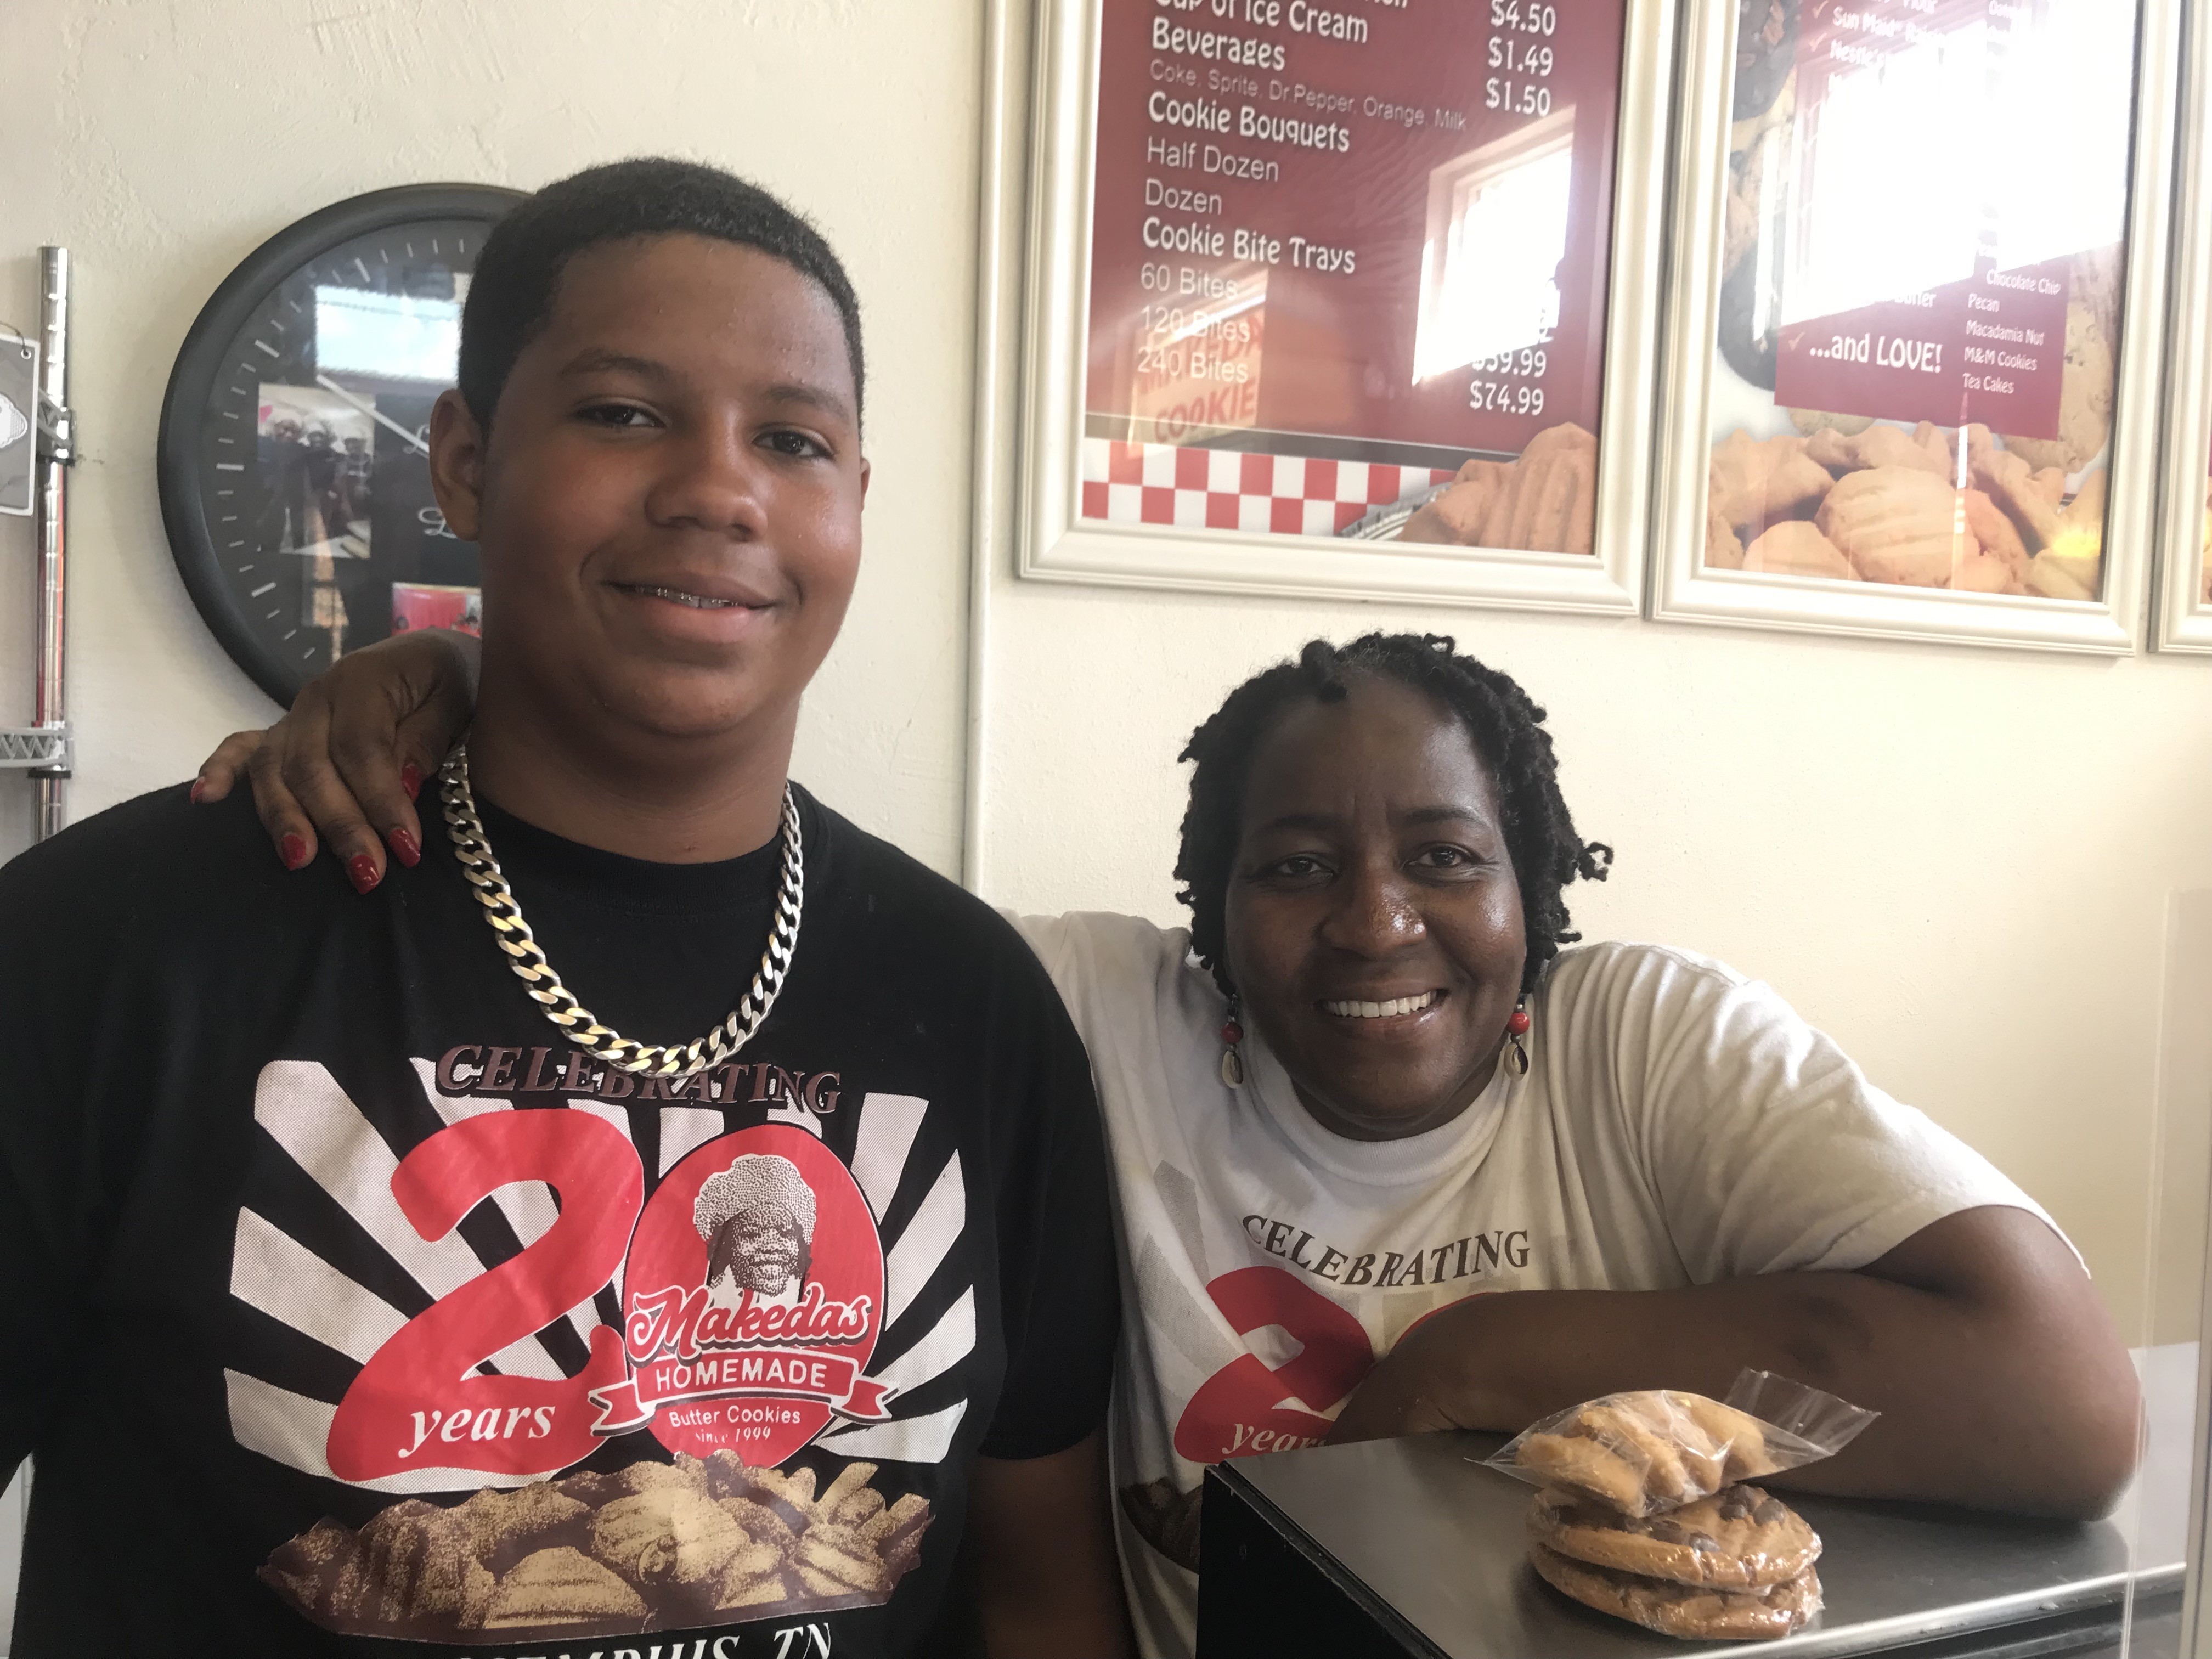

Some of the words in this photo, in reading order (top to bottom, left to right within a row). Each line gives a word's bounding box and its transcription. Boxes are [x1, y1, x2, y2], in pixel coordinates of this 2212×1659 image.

[1245, 0, 1280, 27] Ice
[1289, 0, 1368, 43] Cream
[1490, 0, 1556, 36] $4.50
[1152, 16, 1286, 71] Beverages
[1488, 35, 1554, 77] $1.49
[1485, 77, 1551, 117] $1.50
[1148, 91, 1232, 133] Cookie
[1239, 105, 1350, 153] Bouquets
[1435, 109, 1467, 131] Milk
[1147, 136, 1197, 169] Half
[1203, 145, 1279, 183] Dozen
[1145, 178, 1223, 215] Dozen
[1142, 215, 1225, 257] Cookie
[1233, 229, 1281, 264] Bite
[1289, 236, 1356, 274] Trays
[1141, 262, 1171, 292] 60
[1180, 267, 1238, 301] Bites
[1986, 269, 2037, 291] Chocolate
[2038, 278, 2062, 295] Chip
[1141, 304, 1184, 334] 120
[1968, 292, 2000, 312] Pecan
[1966, 319, 2024, 342] Macadamia
[2025, 329, 2045, 346] Nut
[1137, 346, 1181, 377] 240
[1190, 352, 1250, 384] Bites
[1810, 332, 1870, 363] ...and
[1876, 336, 1943, 374] LOVE!
[1964, 346, 1996, 365] M&M
[1997, 351, 2038, 371] Cookies
[1469, 379, 1545, 415] $74.99
[1962, 373, 1982, 390] Tea
[1983, 376, 2015, 394] Cakes
[1242, 1214, 1531, 1288] CELEBRATING
[656, 1358, 827, 1392] HOMEMADE
[398, 1404, 556, 1458] years
[669, 1408, 720, 1427] Butter
[727, 1405, 801, 1424] Cookies
[773, 1622, 831, 1659] TN
